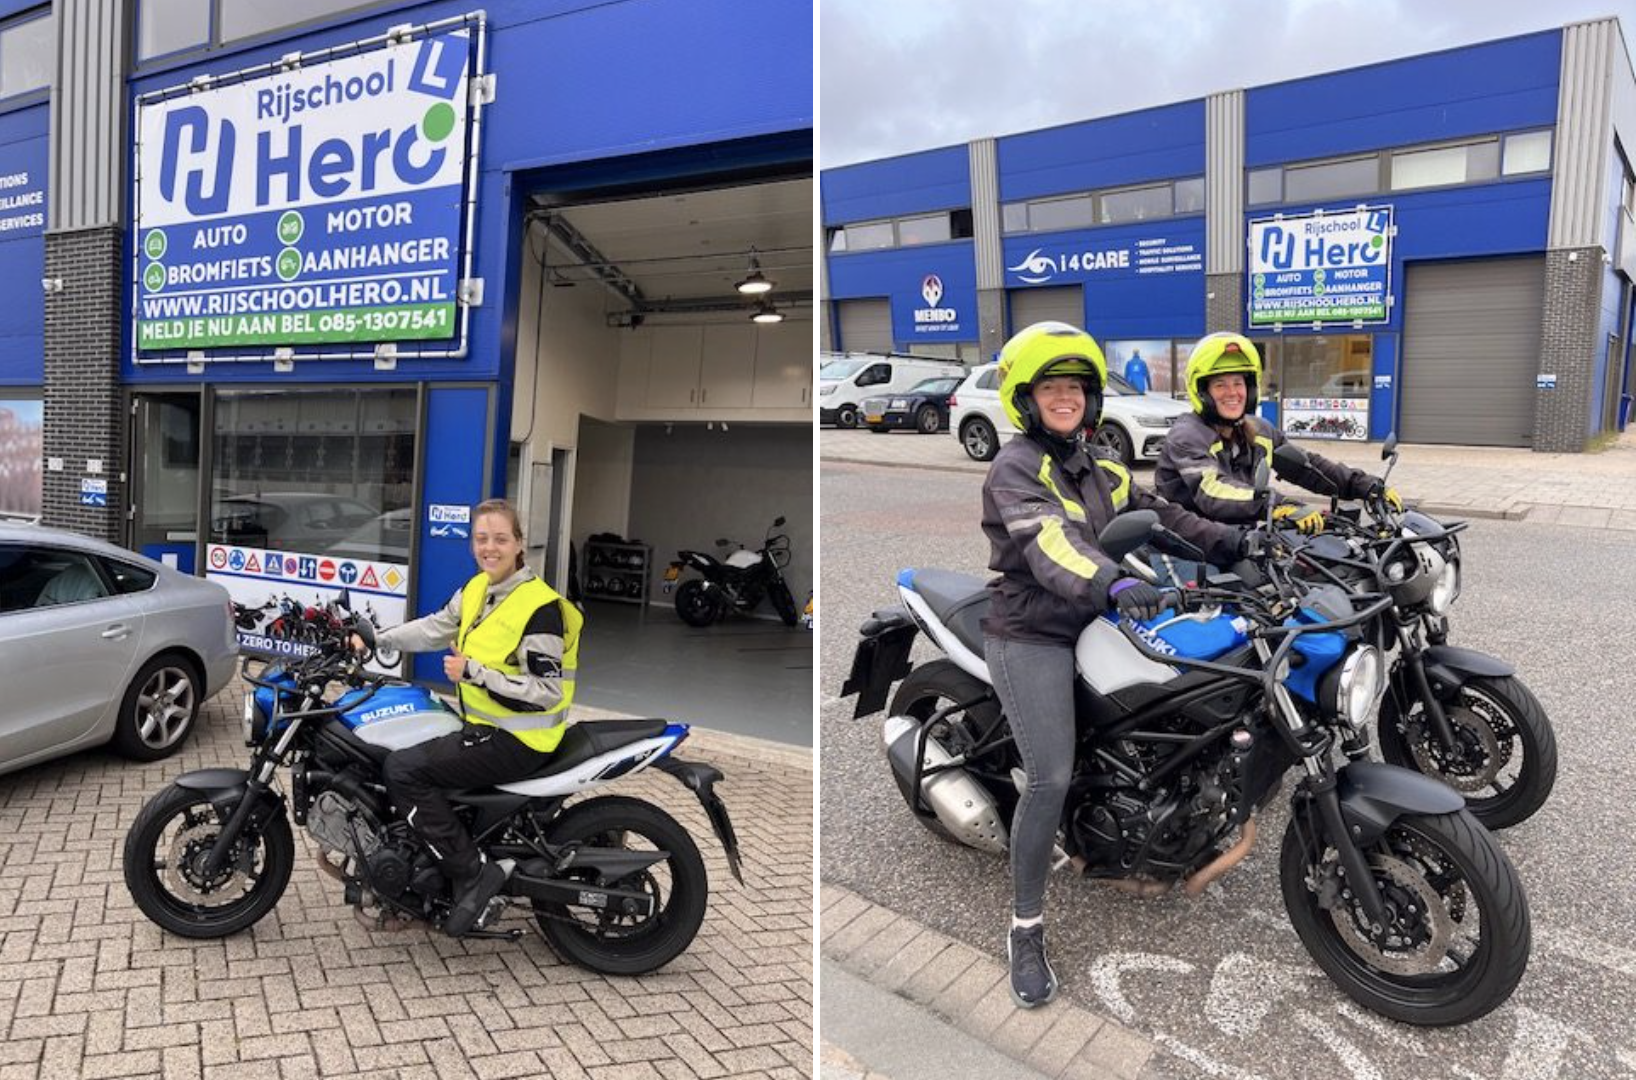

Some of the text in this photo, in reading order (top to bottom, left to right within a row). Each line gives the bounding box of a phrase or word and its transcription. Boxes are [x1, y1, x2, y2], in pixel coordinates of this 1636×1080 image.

[257, 58, 394, 124] Rijschool
[255, 118, 450, 207] Hero
[327, 202, 412, 234] MOTOR
[1305, 218, 1361, 237] Rijschool
[193, 224, 247, 249] AUTO
[303, 237, 449, 273] AANHANGER
[1068, 253, 1080, 271] 4
[1082, 250, 1130, 271] CARE
[1304, 237, 1382, 267] Hero
[168, 256, 272, 285] BROMFIETS
[1276, 273, 1302, 284] AUTO
[1334, 269, 1368, 279] MOTOR
[143, 277, 447, 318] WWW.RIJSCHOOLHERO.NL
[1264, 286, 1312, 297] BROMFIETS
[1326, 281, 1382, 293] AANHANGER
[143, 308, 447, 340] MELD JE NU AAN BEL 085-1307541
[242, 634, 273, 650] ZERO
[275, 640, 292, 653] TO
[361, 702, 415, 722] SUZUKI
